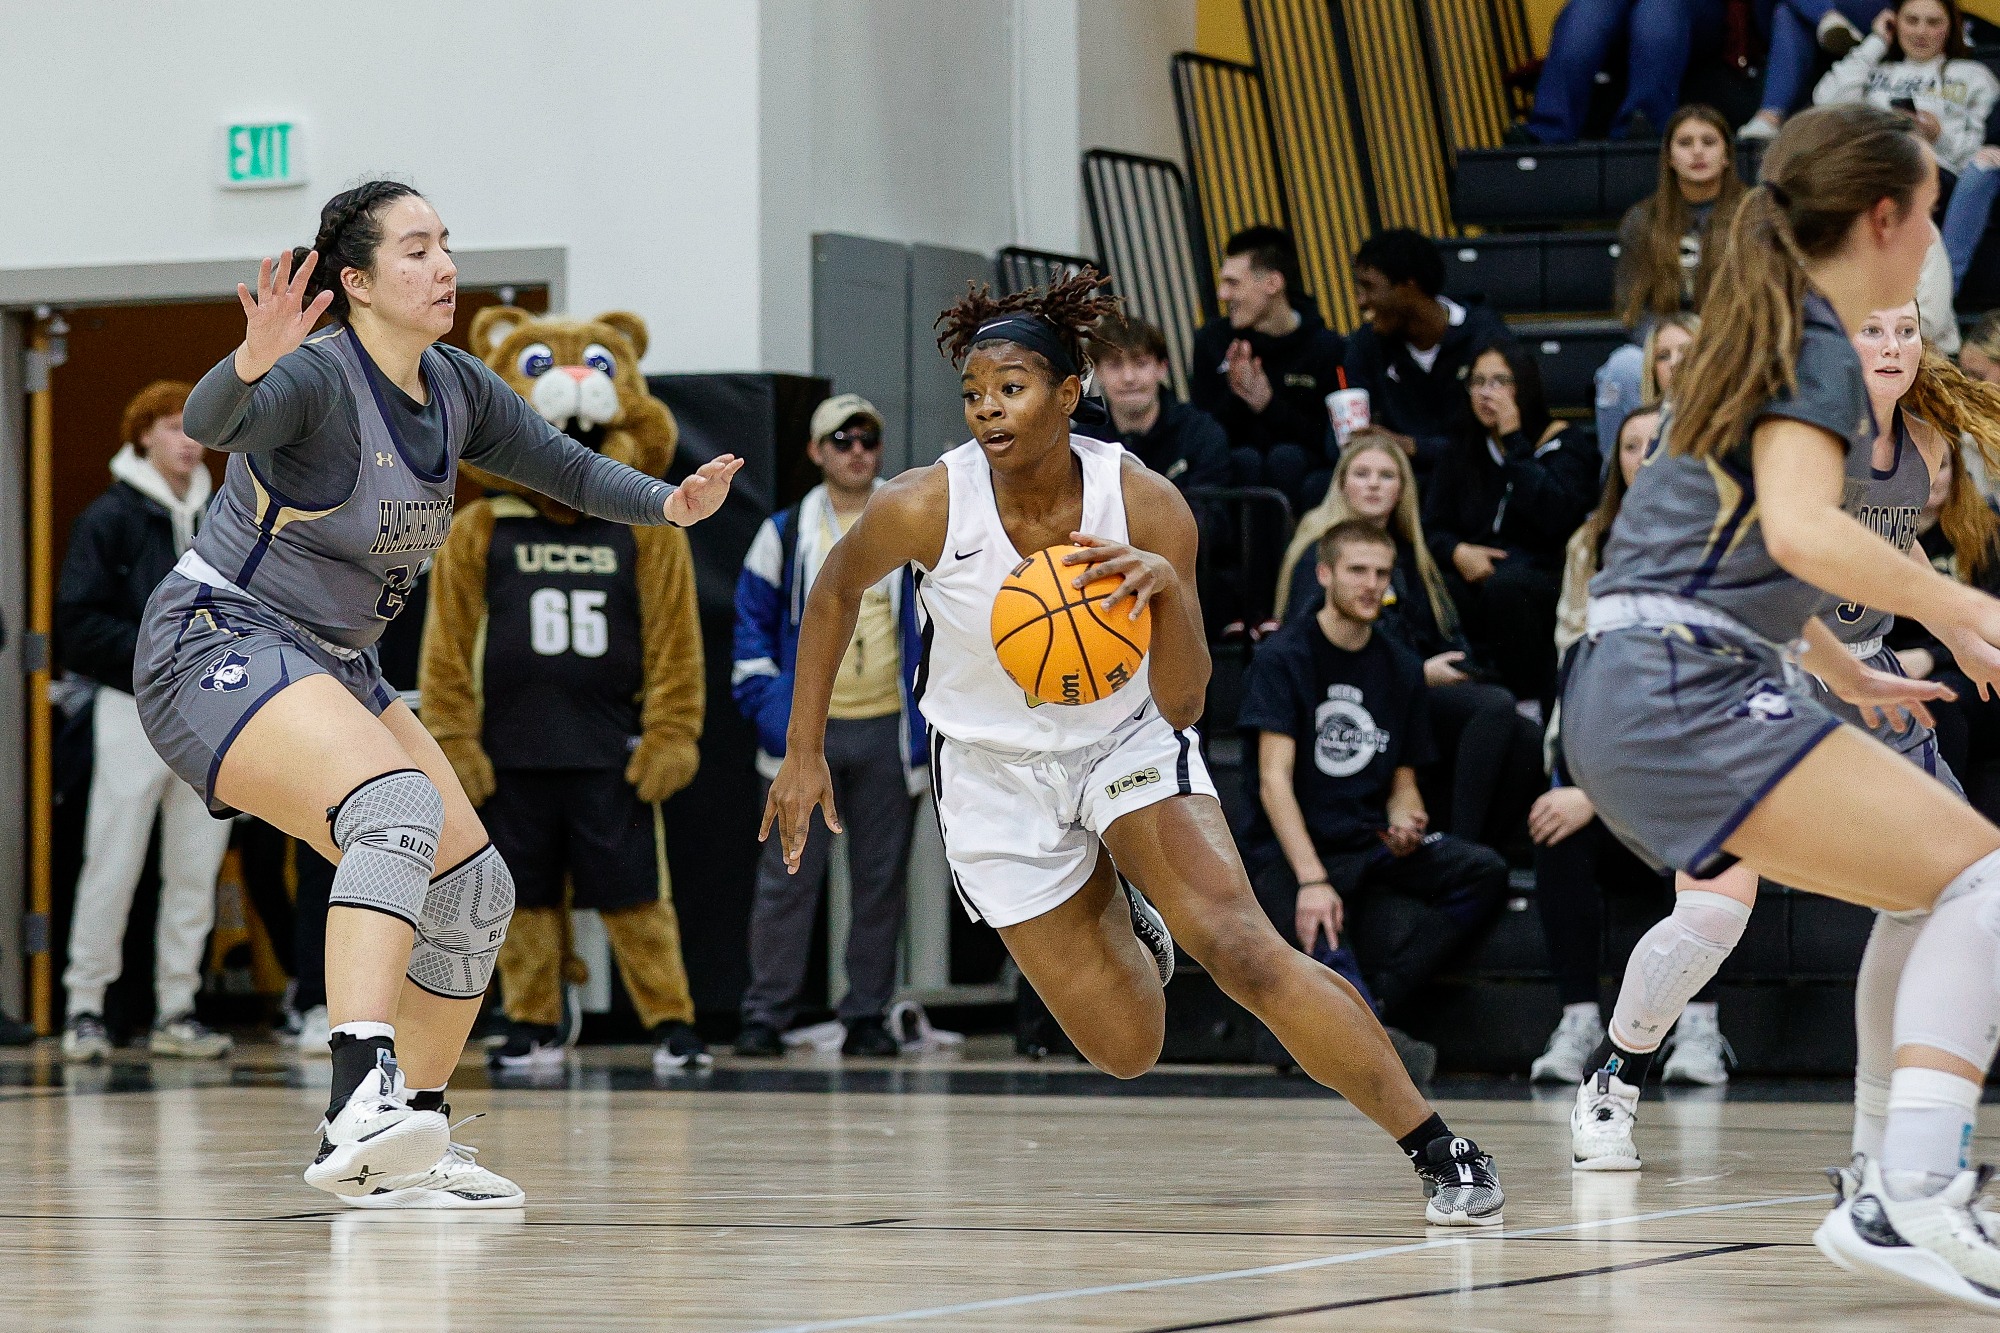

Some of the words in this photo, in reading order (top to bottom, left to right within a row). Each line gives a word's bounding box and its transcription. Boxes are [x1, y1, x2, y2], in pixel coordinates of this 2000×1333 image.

[227, 122, 293, 181] EXIT
[513, 543, 619, 575] UCCS
[529, 587, 609, 658] 65
[1104, 766, 1161, 800] UCCS
[399, 834, 436, 863] BLITZ
